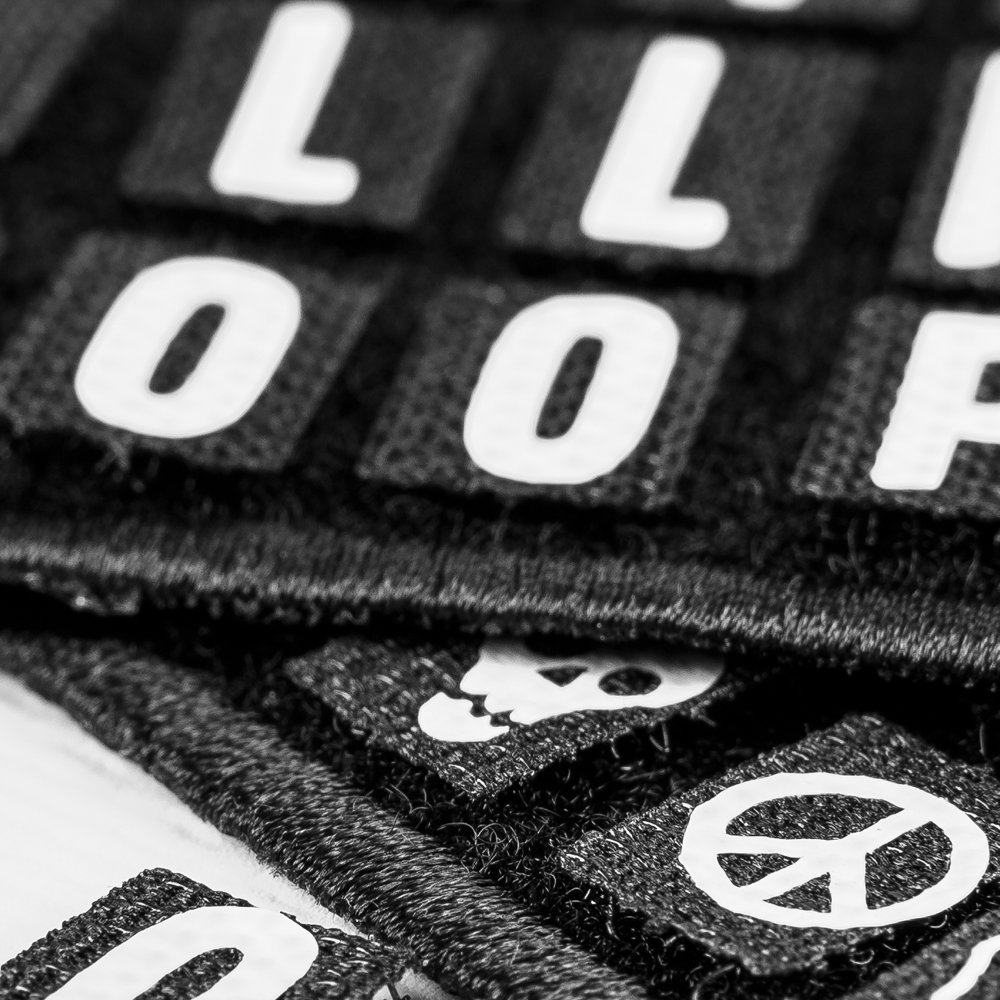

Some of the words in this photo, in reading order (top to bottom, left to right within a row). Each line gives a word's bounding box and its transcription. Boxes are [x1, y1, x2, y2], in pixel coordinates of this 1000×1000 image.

[211, 1, 359, 205] L
[580, 36, 730, 251] L
[74, 257, 301, 439] O
[463, 294, 680, 486] O
